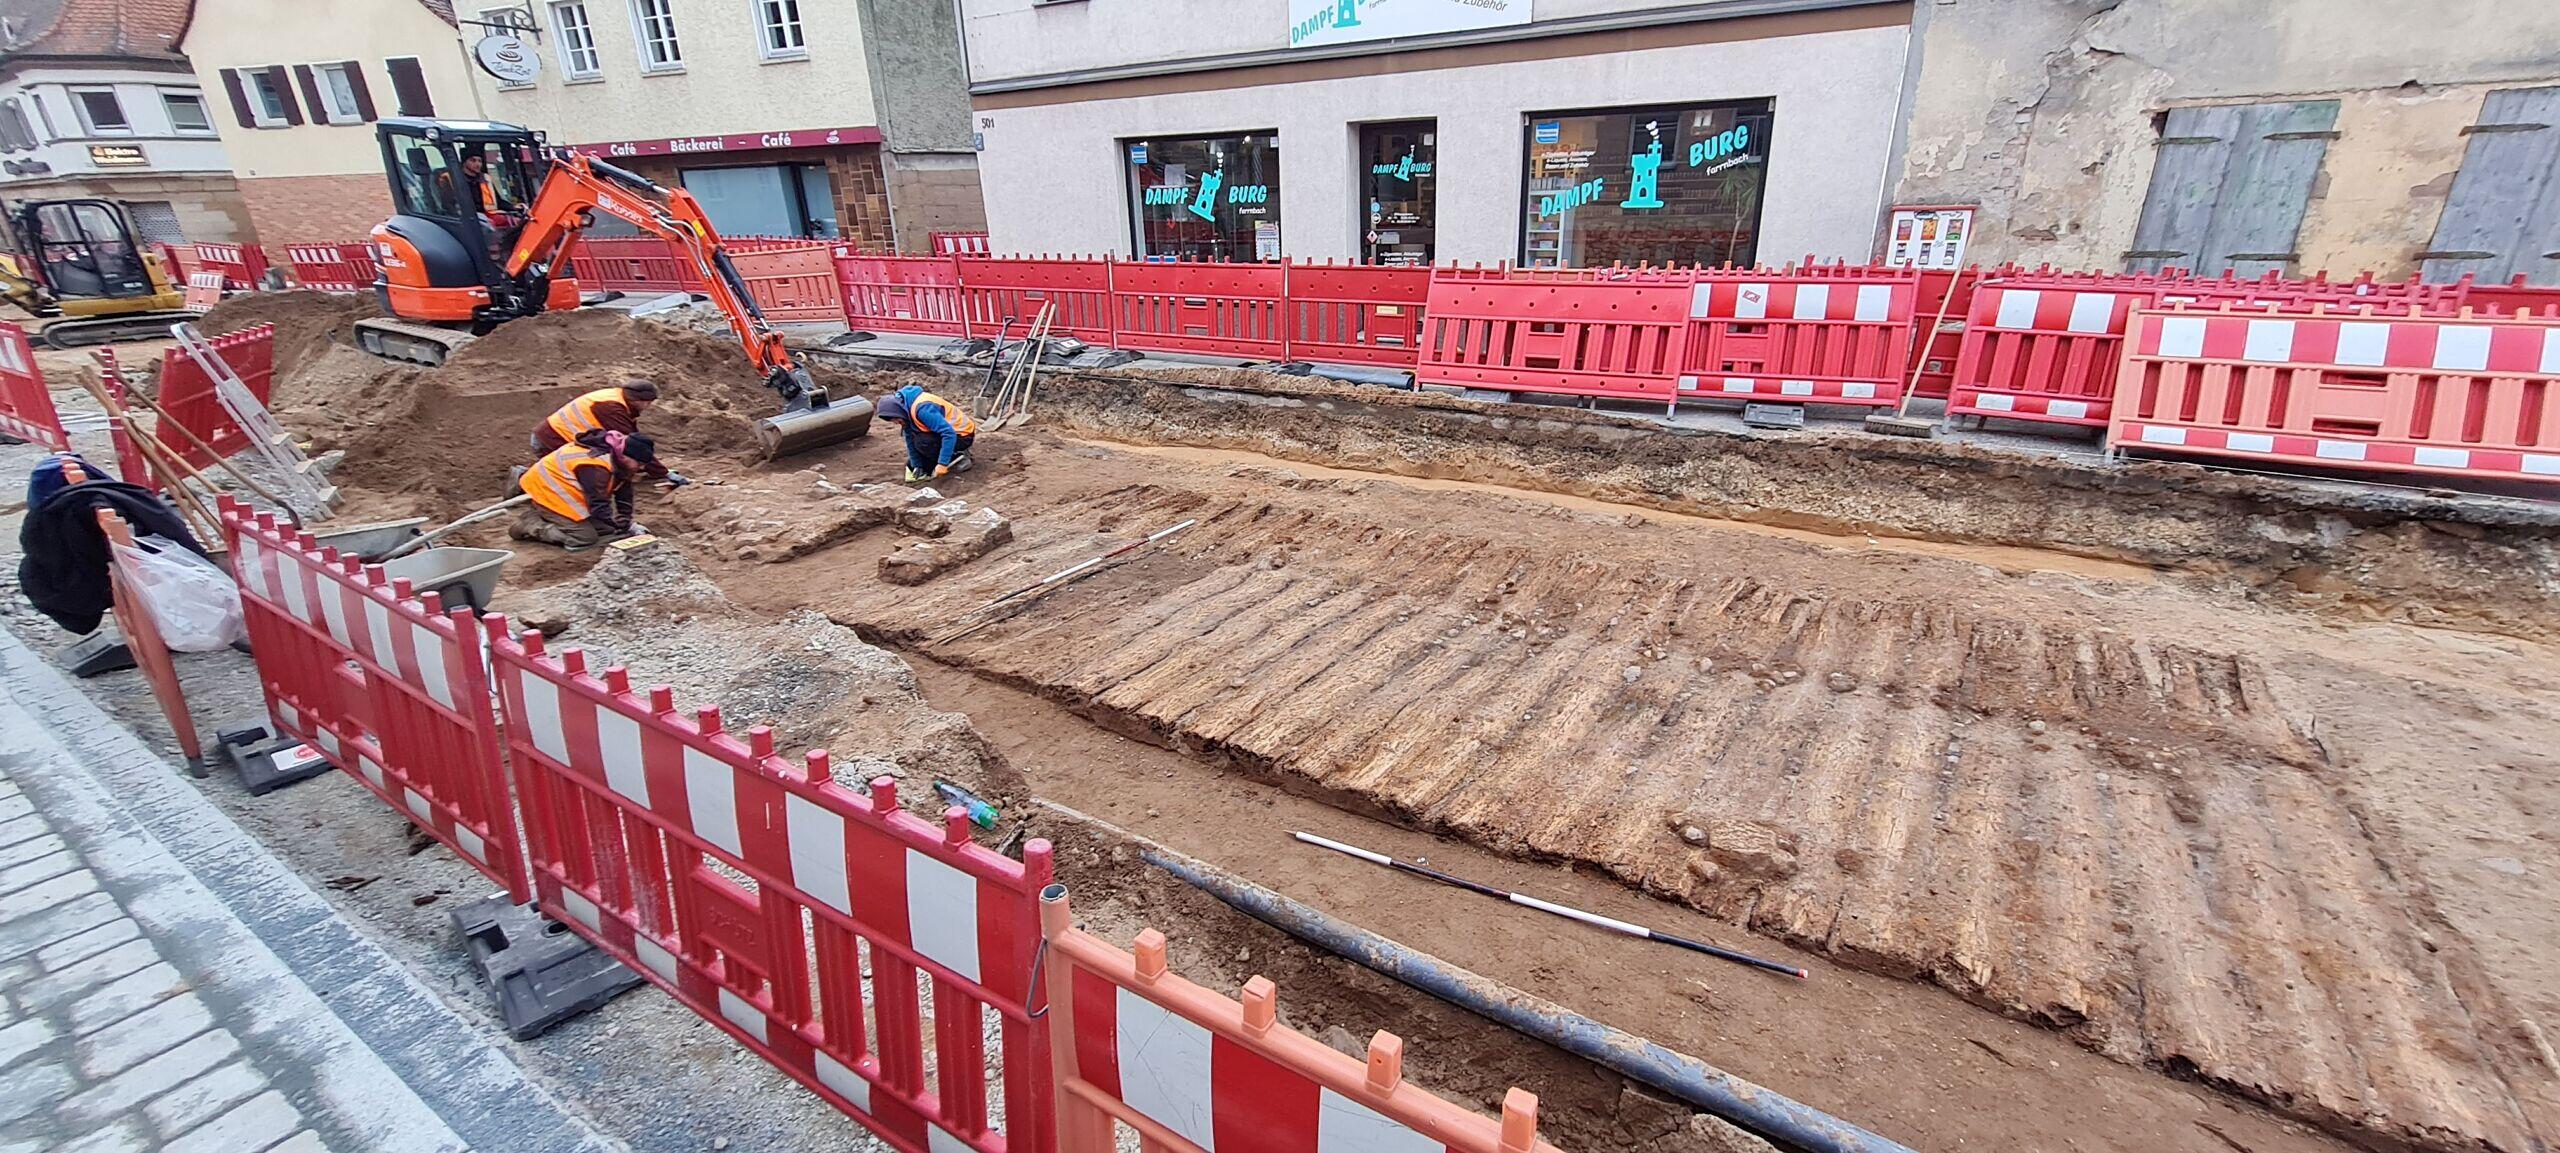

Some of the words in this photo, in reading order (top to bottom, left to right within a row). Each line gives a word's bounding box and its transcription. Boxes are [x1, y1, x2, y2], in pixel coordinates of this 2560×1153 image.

[1292, 5, 1334, 43] DAMPF
[981, 117, 995, 129] 501
[610, 143, 637, 157] Café
[670, 137, 724, 153] Bäckerei
[761, 133, 792, 147] Café
[1372, 164, 1399, 174] DAMPF
[1410, 163, 1432, 172] BURG
[1541, 178, 1603, 217] DAMPF
[1690, 125, 1748, 167] BURG
[1145, 187, 1189, 205] DAMPF
[1228, 185, 1267, 203] BURG
